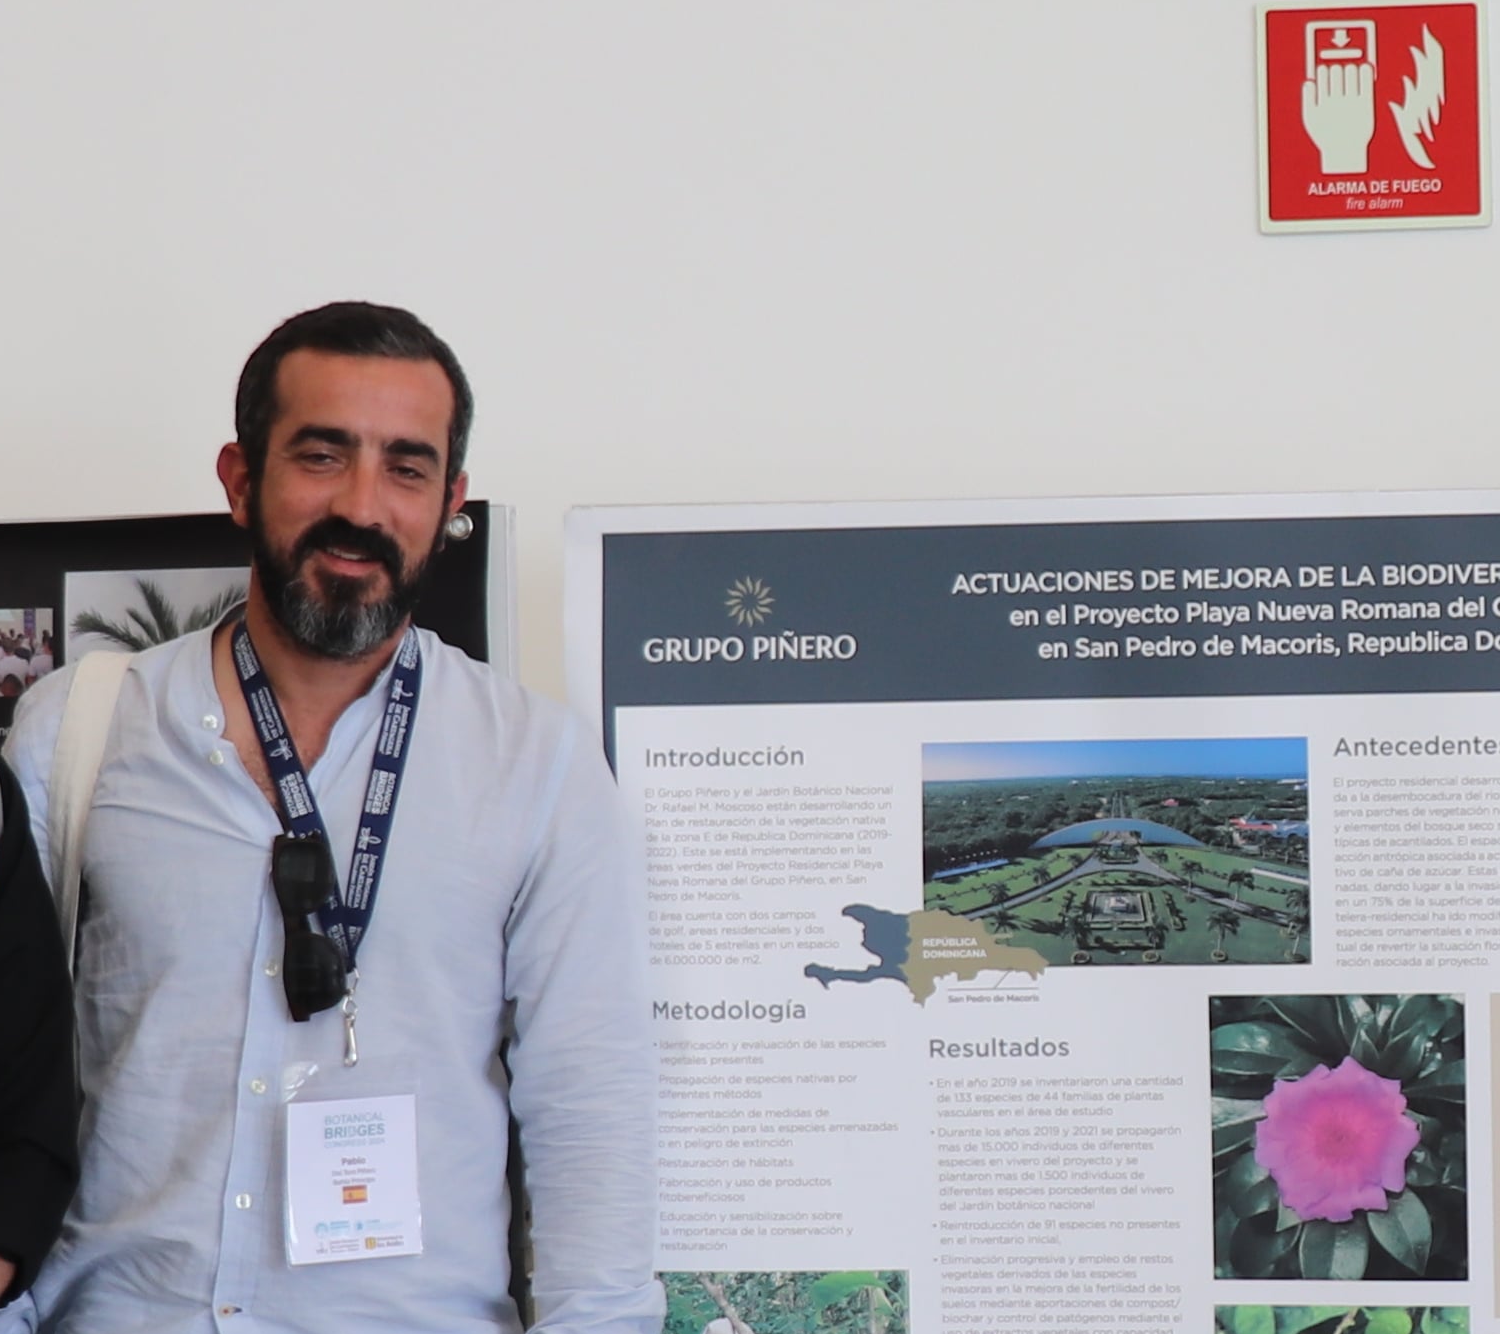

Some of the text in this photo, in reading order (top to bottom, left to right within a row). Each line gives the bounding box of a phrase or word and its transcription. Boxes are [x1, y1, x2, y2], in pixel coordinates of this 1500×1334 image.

[1307, 177, 1442, 196] ALARMA DE FUEGO
[1345, 195, 1404, 210] fire alarm
[950, 569, 1134, 594] ACTUACIONES
[1140, 568, 1176, 591] DE
[1181, 566, 1292, 590] MEJORA
[1298, 565, 1334, 588] DE
[1340, 565, 1376, 587] LA
[1008, 609, 1039, 626] en
[1044, 603, 1066, 626] el
[1073, 603, 1180, 628] Proyecto
[1185, 600, 1250, 627] Playa
[1256, 600, 1334, 622] Nueva
[1340, 598, 1441, 620] Romana
[1446, 595, 1485, 618] del
[642, 629, 856, 663] GRUPO PIÑERO
[1037, 641, 1068, 659] en
[1074, 636, 1118, 658] San
[1125, 634, 1196, 657] Pedro
[1202, 633, 1234, 656] de
[1240, 631, 1341, 657] Macoris,
[1347, 629, 1468, 657] Republica
[645, 744, 804, 768] Introducción
[922, 948, 987, 959] DOMINICANA
[651, 998, 806, 1023] Metodología
[928, 1036, 1070, 1058] Resultados
[324, 1111, 385, 1126] BOTANICAL
[324, 1123, 386, 1140] BRIDGES
